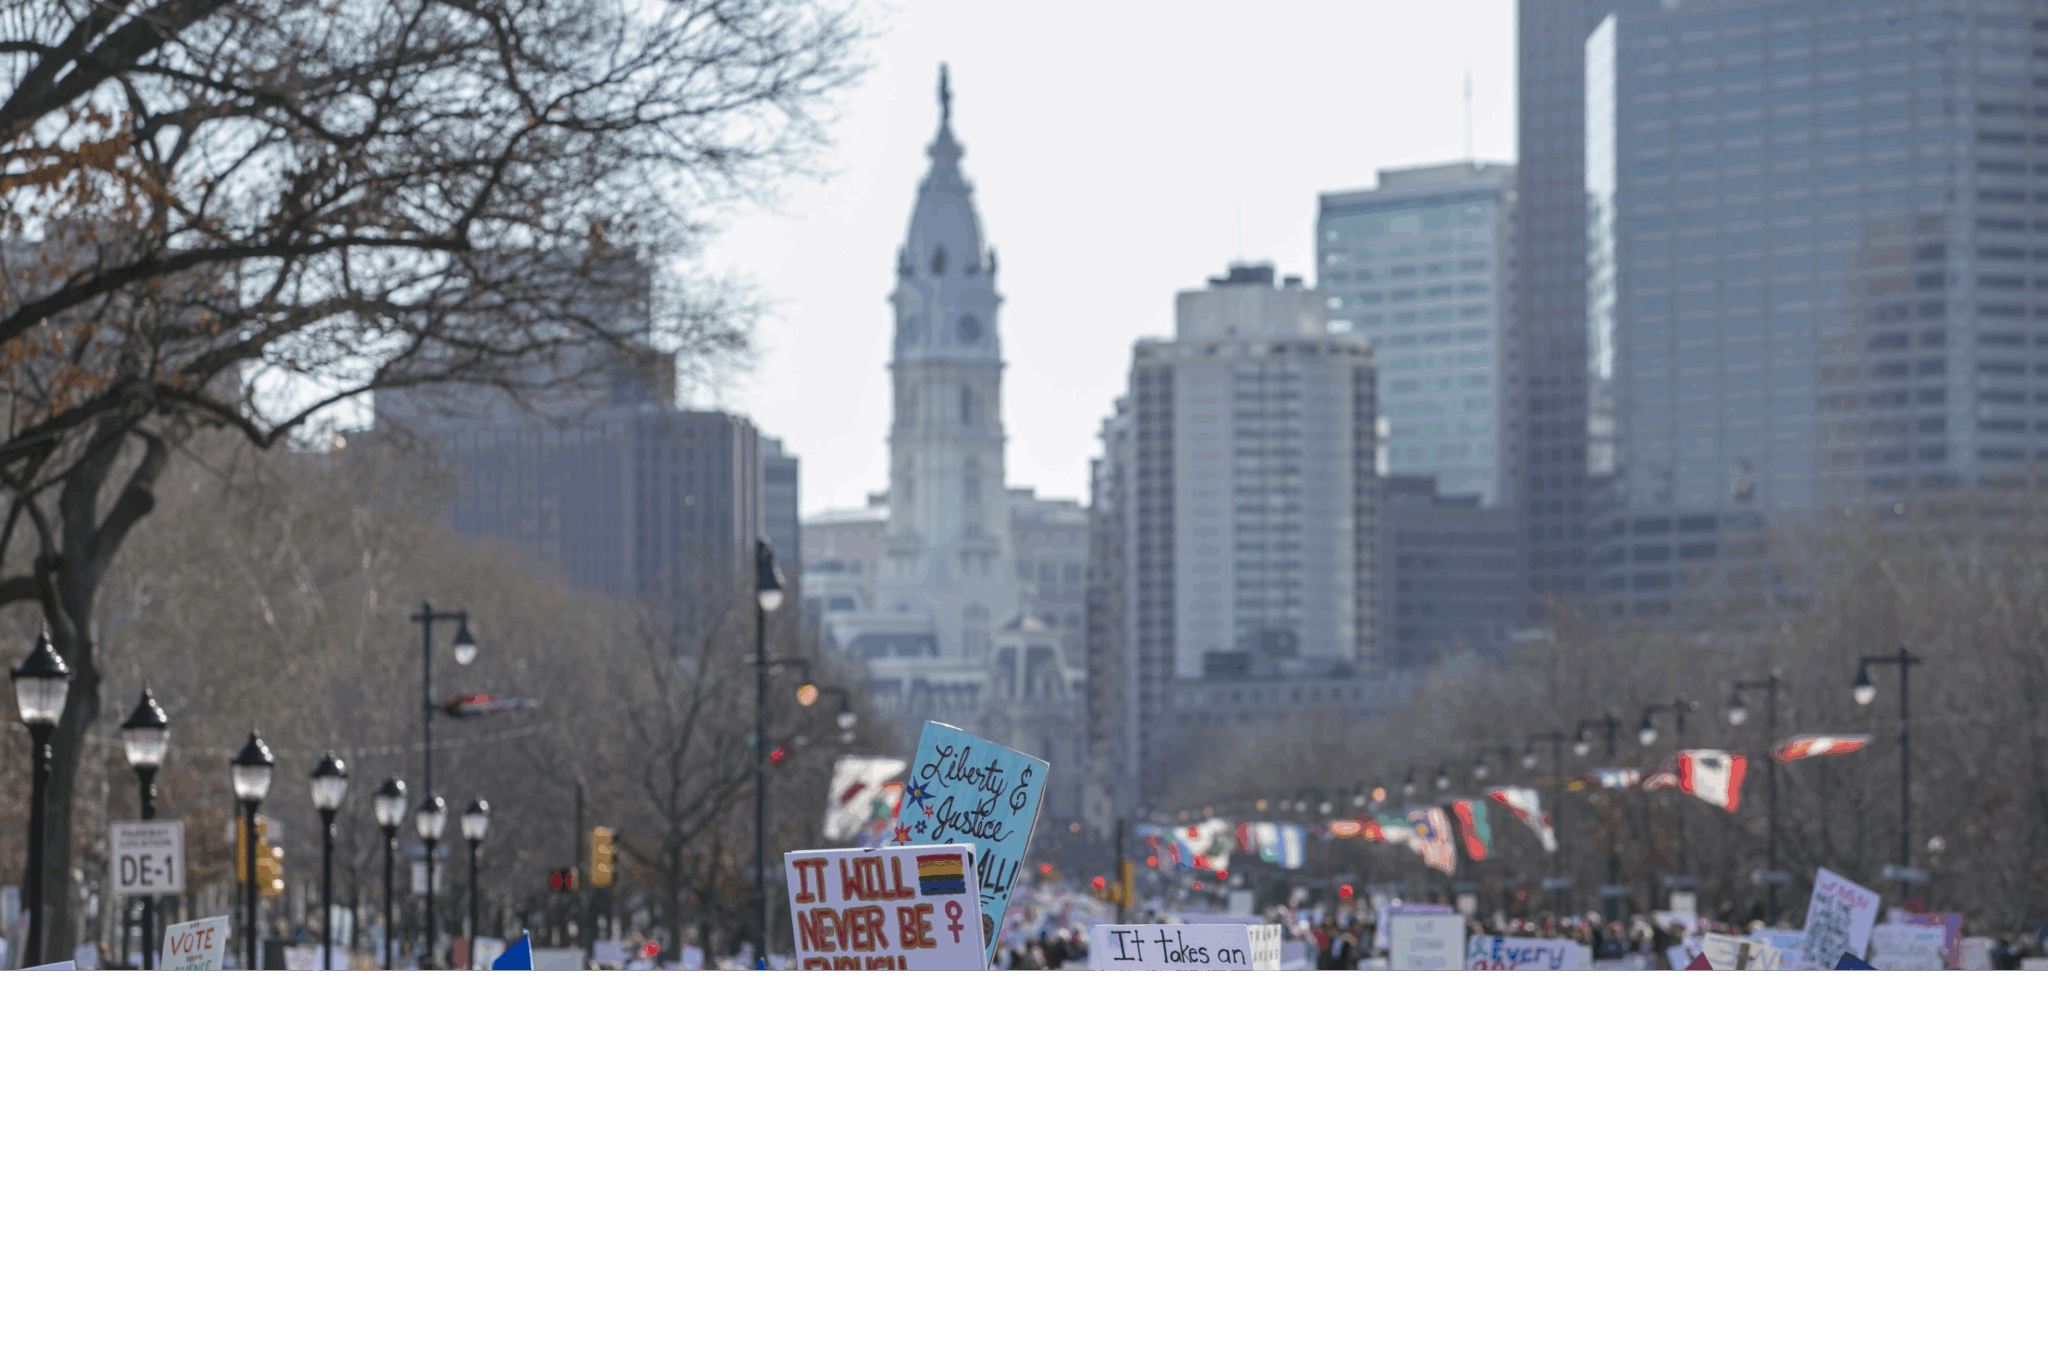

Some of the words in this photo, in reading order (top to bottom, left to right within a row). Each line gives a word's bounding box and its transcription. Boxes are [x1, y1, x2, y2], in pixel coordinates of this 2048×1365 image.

[921, 745, 1008, 817] Liberty
[1009, 764, 1032, 816] &
[931, 796, 1014, 842] Justice
[120, 853, 174, 887] DE-1
[792, 858, 829, 903] IT
[839, 856, 916, 902] WILL
[171, 927, 214, 956] VOTE
[797, 905, 889, 952] NEVER
[896, 903, 937, 950] BE
[1111, 929, 1145, 962] It
[1154, 929, 1210, 964] takes
[1217, 947, 1246, 965] an
